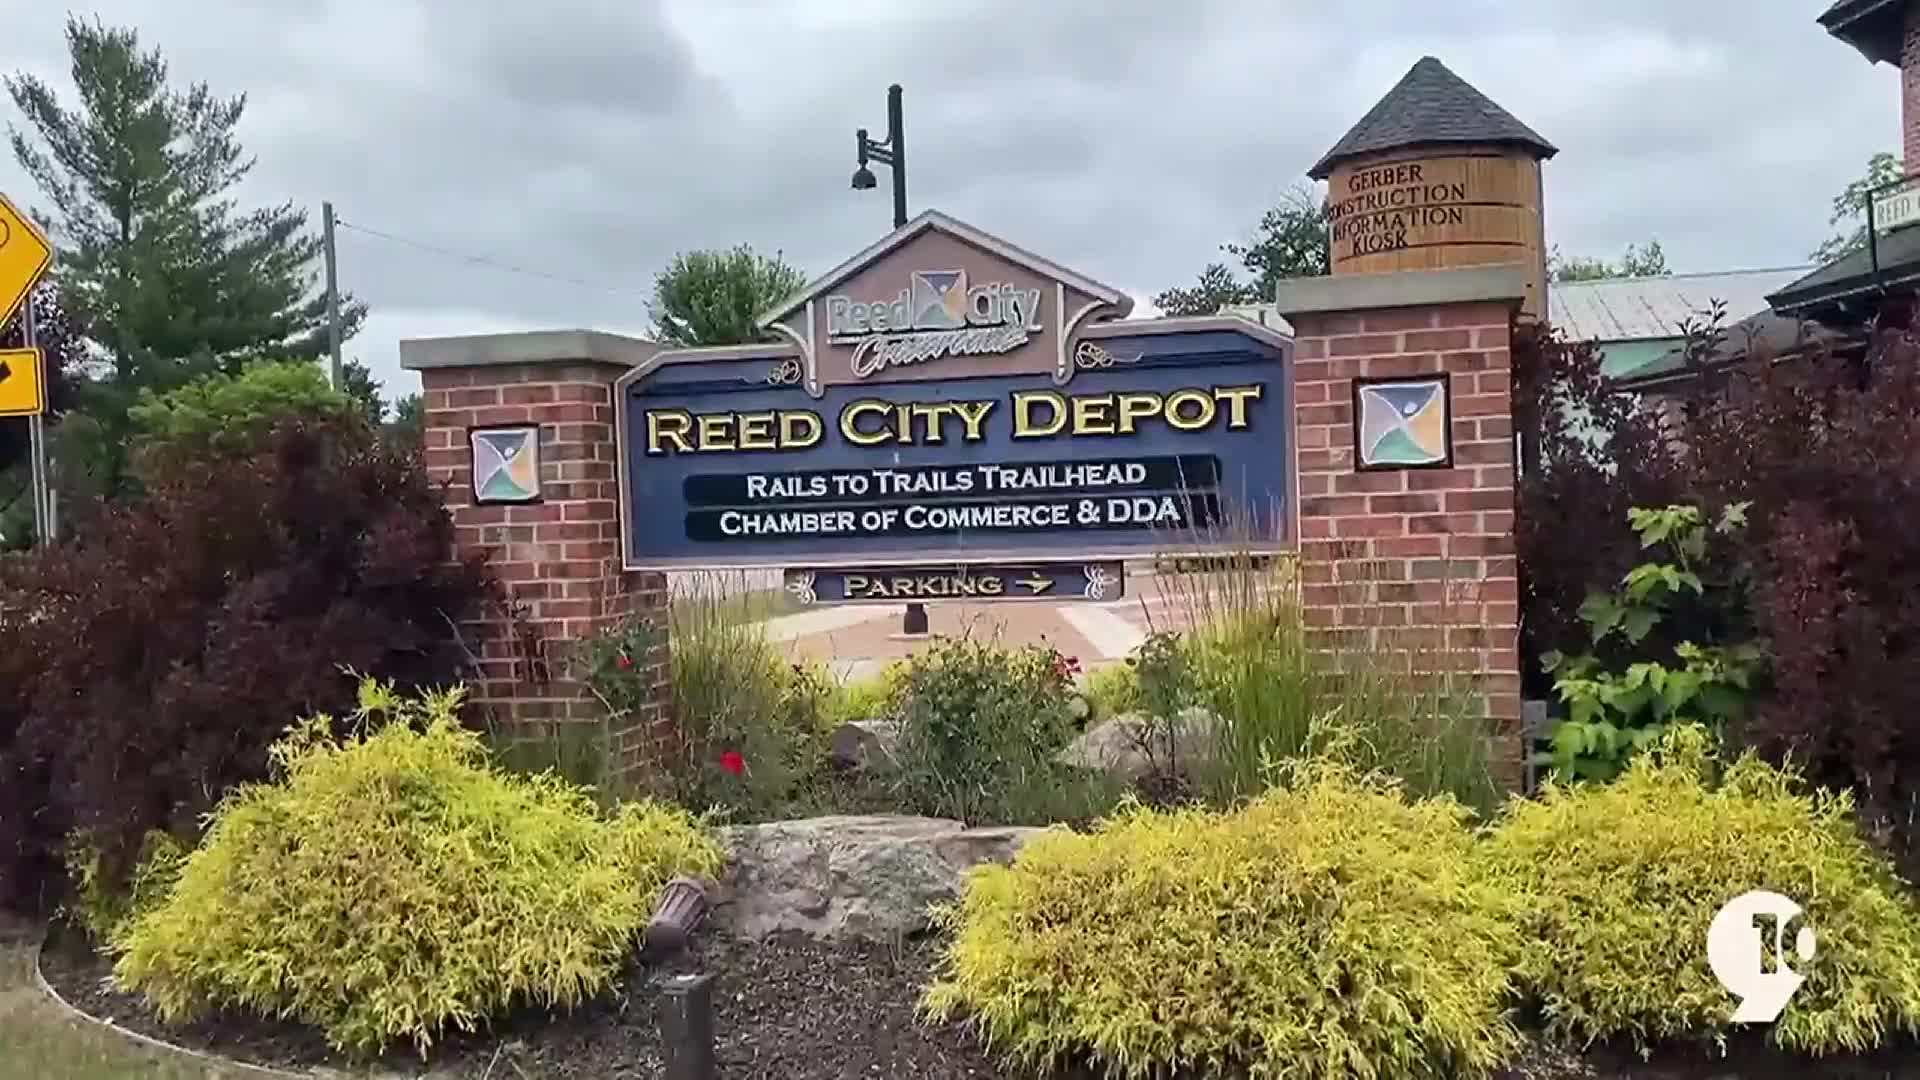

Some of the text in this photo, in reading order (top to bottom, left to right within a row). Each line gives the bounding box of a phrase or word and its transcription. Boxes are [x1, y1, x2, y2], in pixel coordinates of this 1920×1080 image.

[1349, 164, 1423, 193] GERBER
[1328, 183, 1465, 221] ONSTRUCTION
[1353, 229, 1409, 257] KIOSK
[826, 282, 1041, 335] Reed City
[646, 382, 1261, 454] REED CITY DEPOT
[747, 462, 1147, 499] RAILS TO TRAILS TRAILHEAD
[719, 495, 1182, 535] CHAMBER OF COMMERCE & DDA
[842, 574, 1005, 599] PARKING
